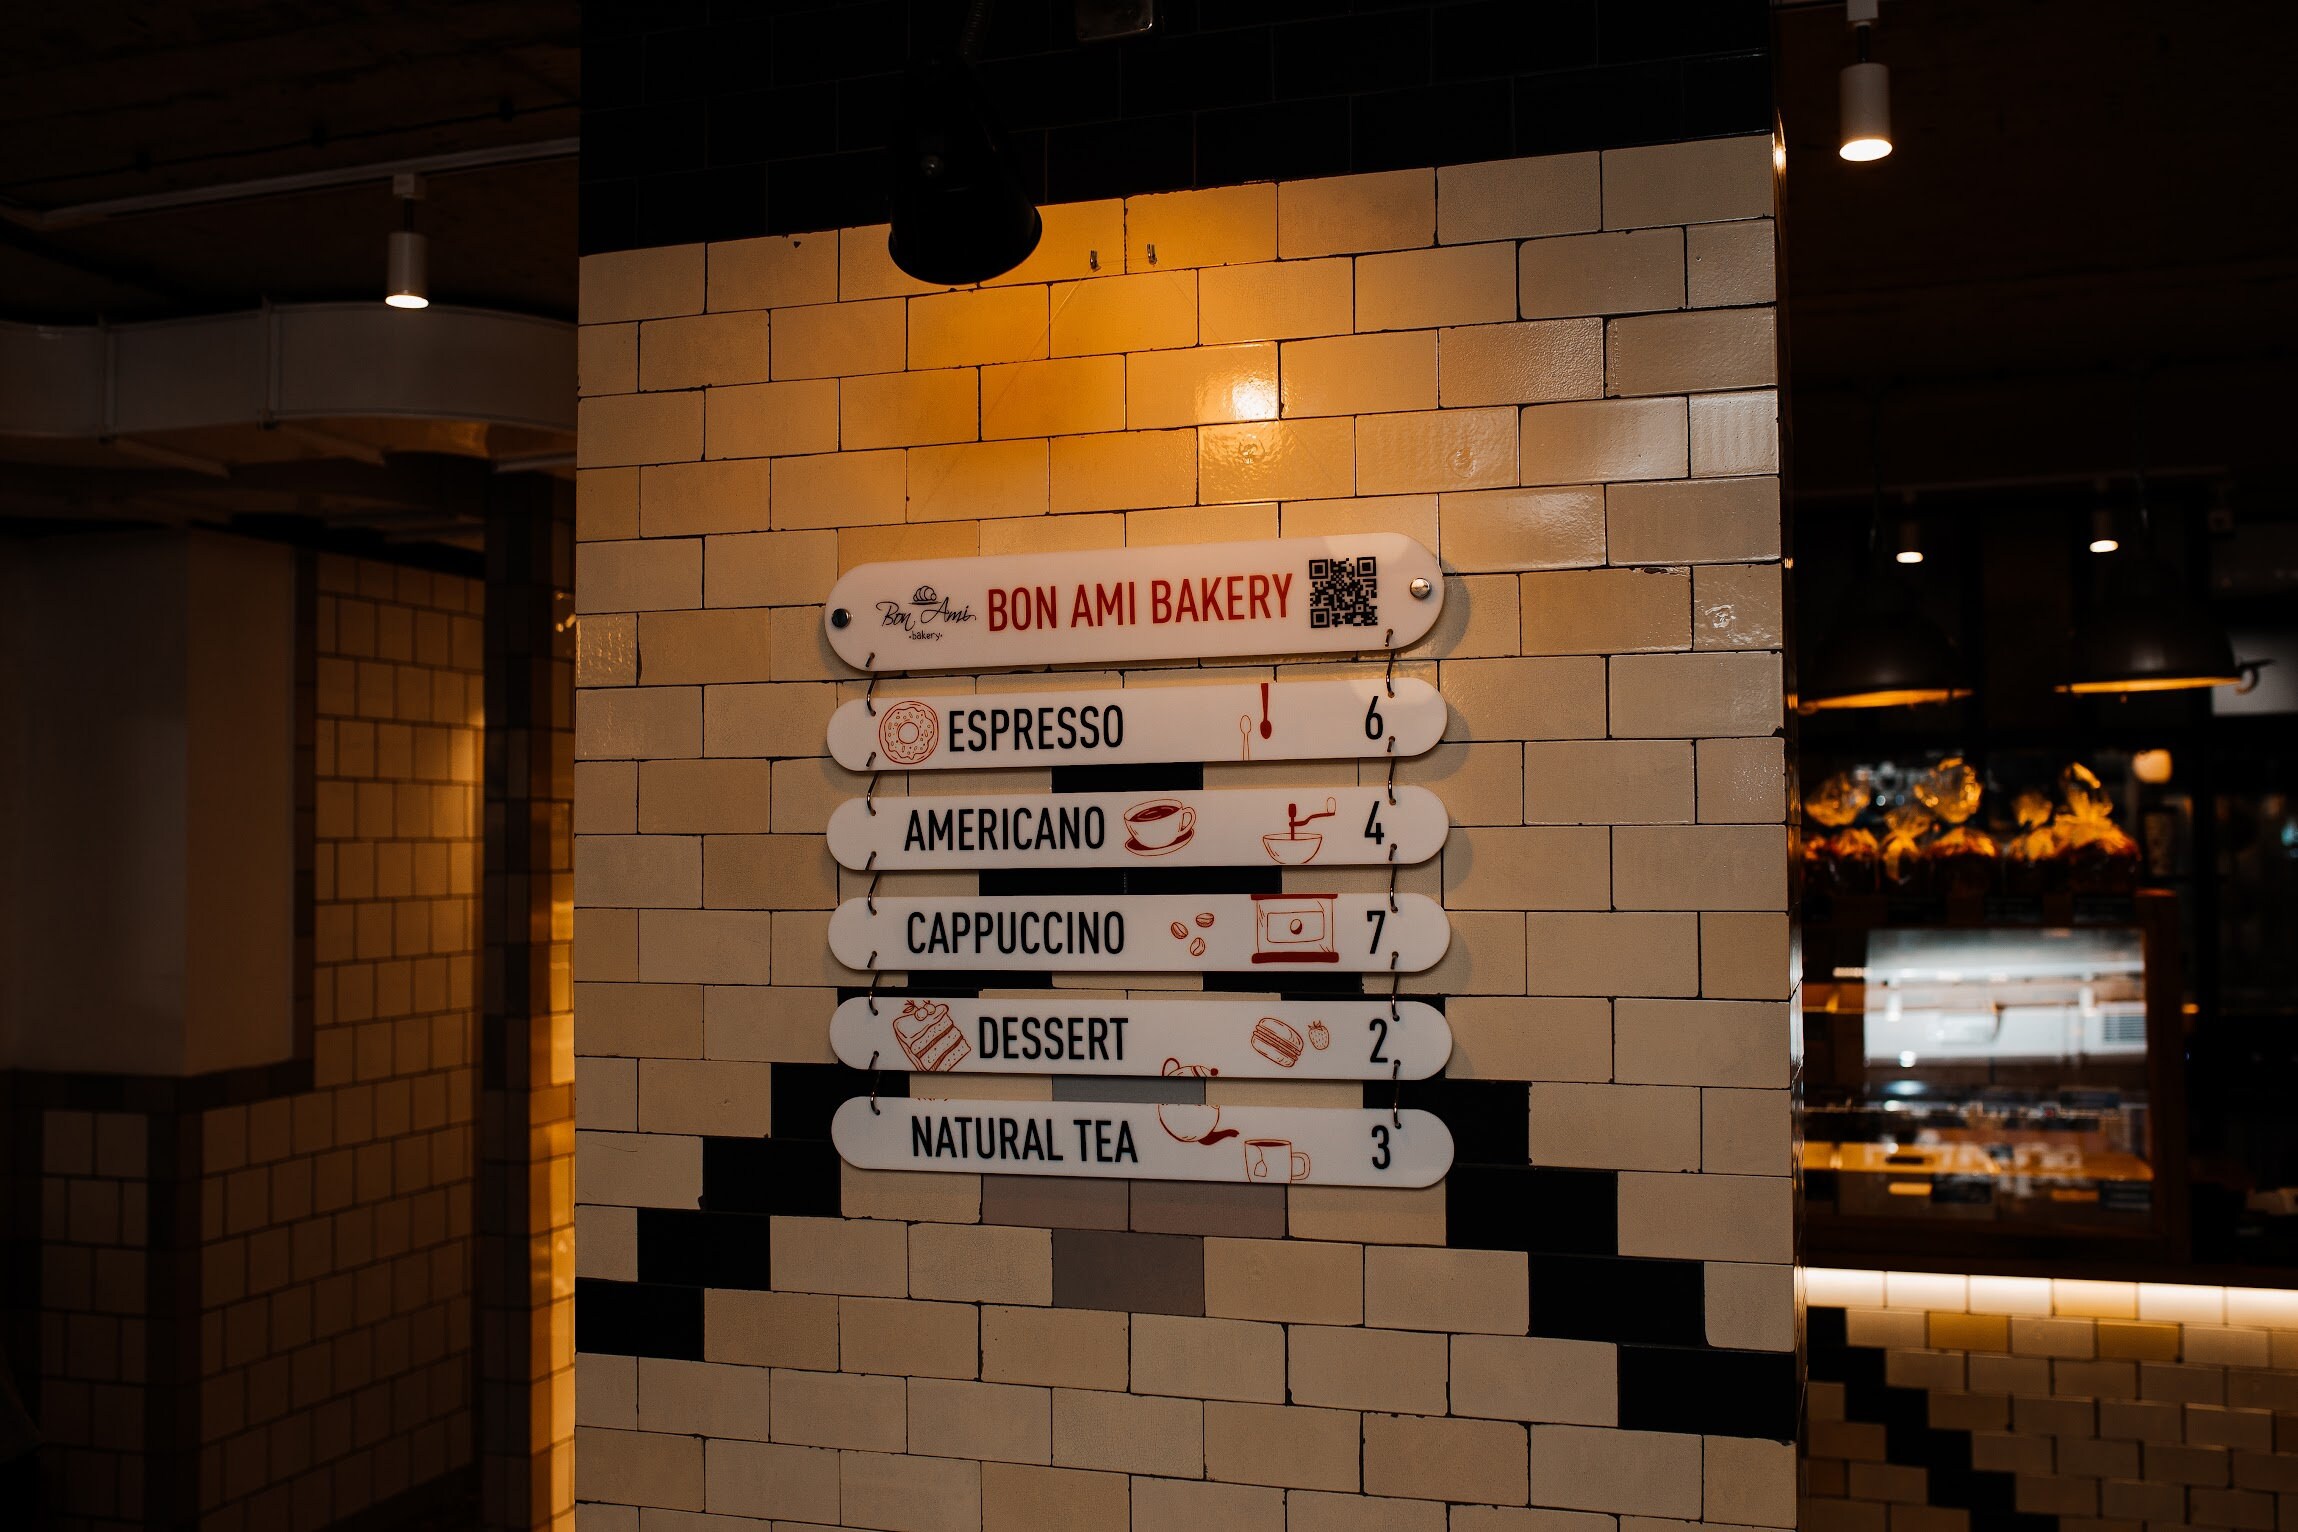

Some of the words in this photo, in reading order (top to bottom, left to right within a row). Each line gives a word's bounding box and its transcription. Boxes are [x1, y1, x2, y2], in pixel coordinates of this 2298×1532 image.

[875, 601, 916, 632] Bon
[920, 596, 977, 624] Ami
[988, 585, 1057, 632] BON
[1070, 581, 1136, 629] AMI
[1151, 572, 1293, 625] BAKERY
[911, 630, 941, 642] bakery
[948, 704, 1124, 753] ESPRESSO
[1364, 695, 1384, 741] 6
[903, 805, 1105, 852] AMERICANO
[1363, 800, 1385, 846] 4
[907, 910, 1125, 955] CAPPUCCINO
[1366, 909, 1386, 955] 7
[978, 1016, 1129, 1061] DESSERT
[1368, 1017, 1389, 1064] 2
[911, 1115, 1064, 1162] NATURAL
[1072, 1119, 1139, 1164] TEA
[1371, 1125, 1392, 1170] 3
